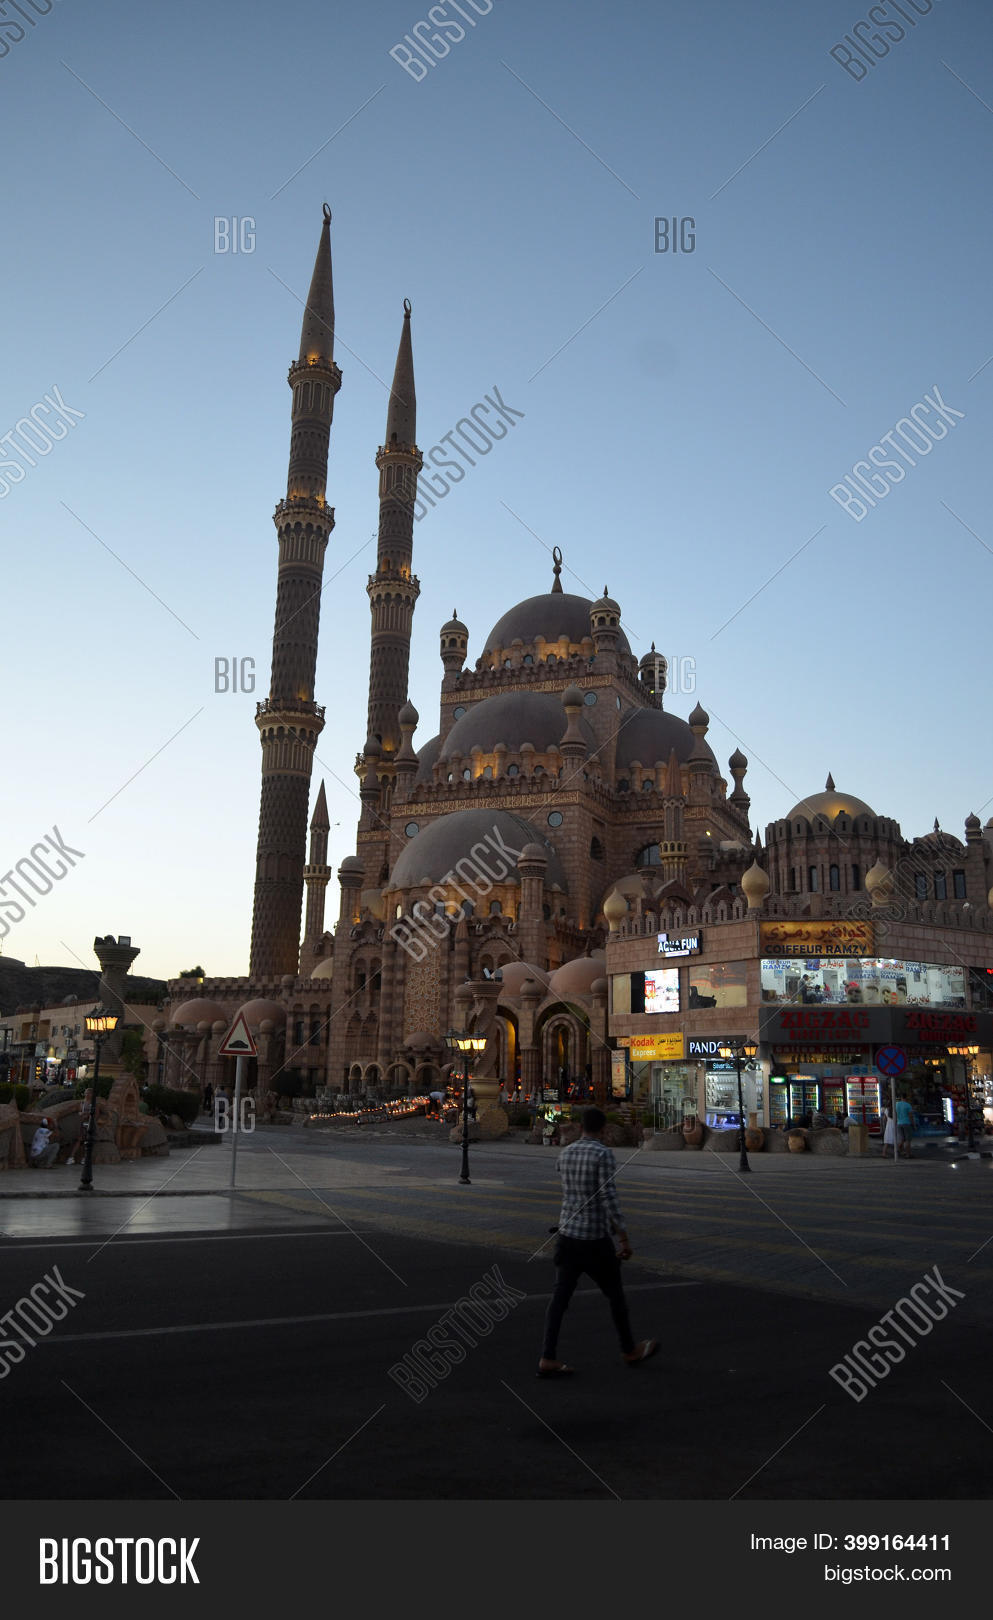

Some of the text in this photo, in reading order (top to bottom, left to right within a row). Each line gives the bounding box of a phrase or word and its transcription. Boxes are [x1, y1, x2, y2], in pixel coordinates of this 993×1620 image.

[681, 937, 698, 950] FUN
[764, 944, 867, 954] COIFFEUR RAMZY
[780, 1011, 870, 1028] ZIGZAG
[904, 1011, 978, 1032] ZIGZAG
[630, 1036, 655, 1047] Kodak
